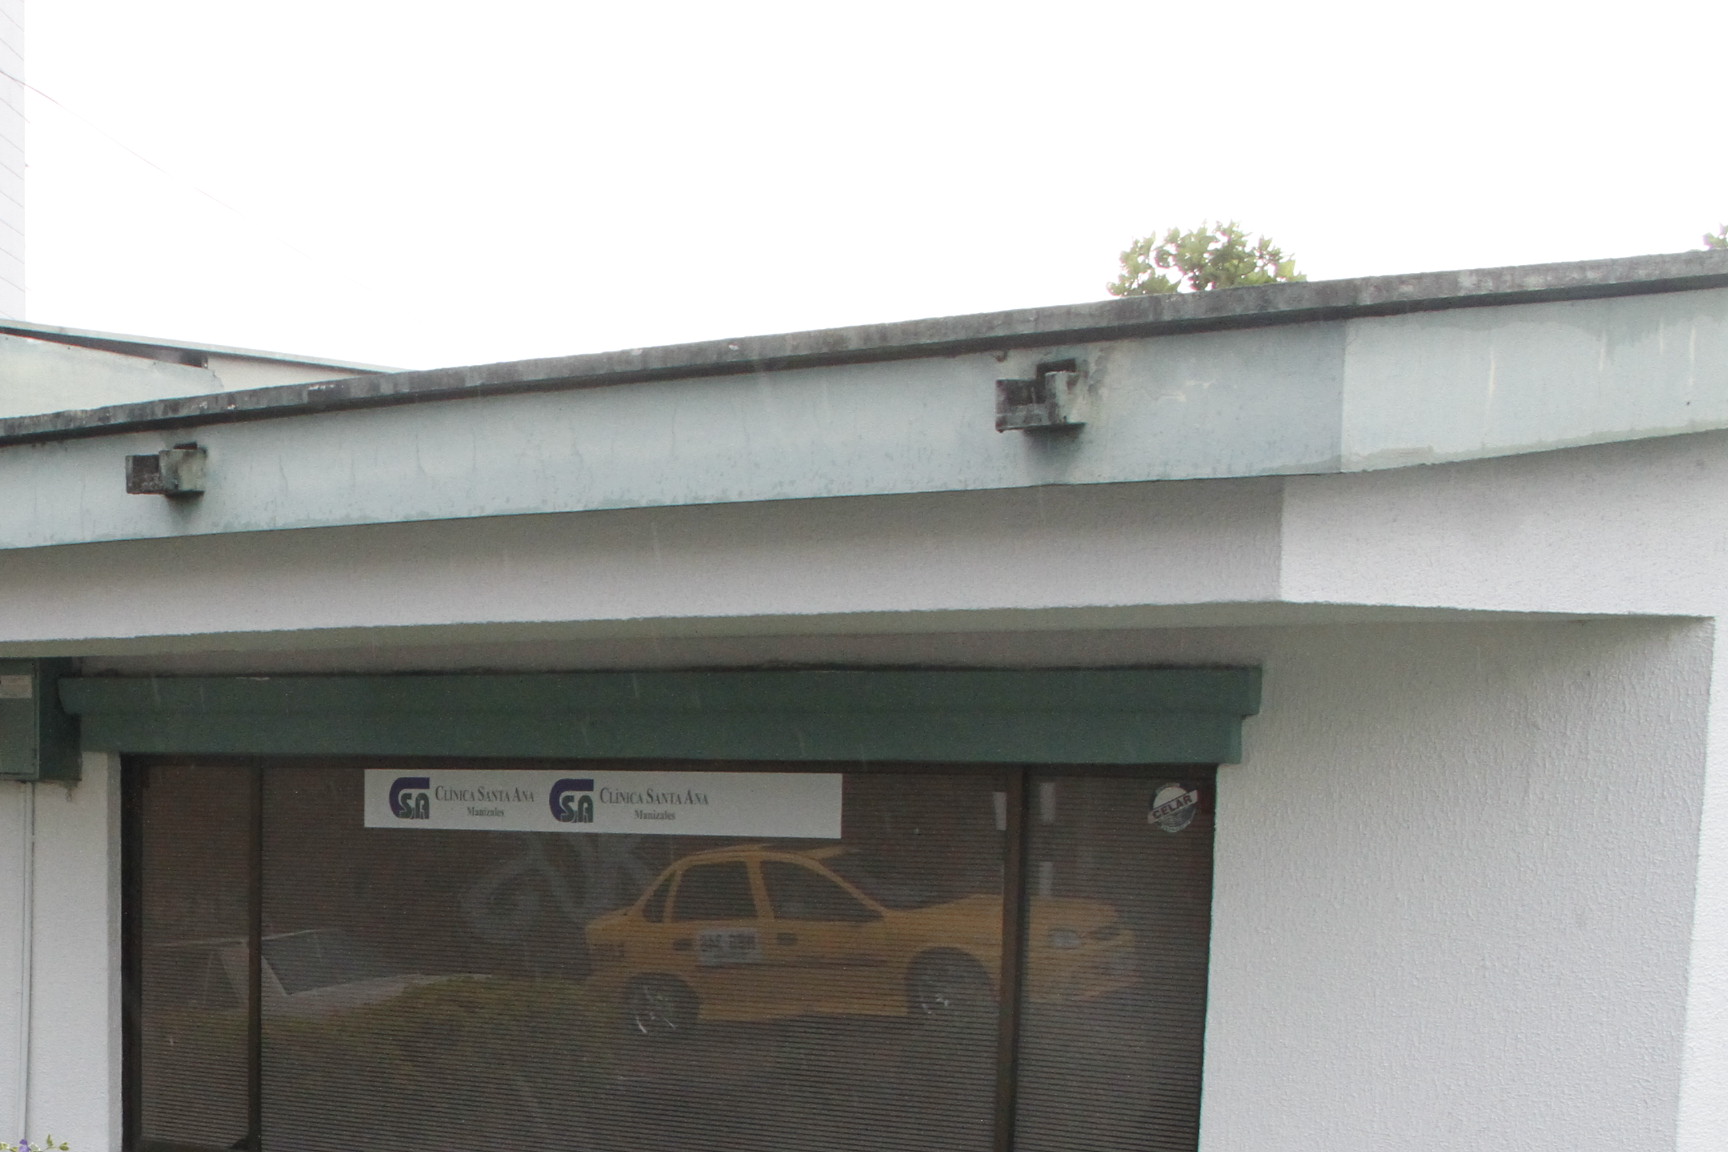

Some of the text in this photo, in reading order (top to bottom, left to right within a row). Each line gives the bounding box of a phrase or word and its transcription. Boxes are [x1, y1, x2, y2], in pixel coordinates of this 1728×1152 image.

[467, 806, 504, 817] Manizales
[1152, 794, 1193, 819] CELAR
[634, 809, 676, 820] Manizales
